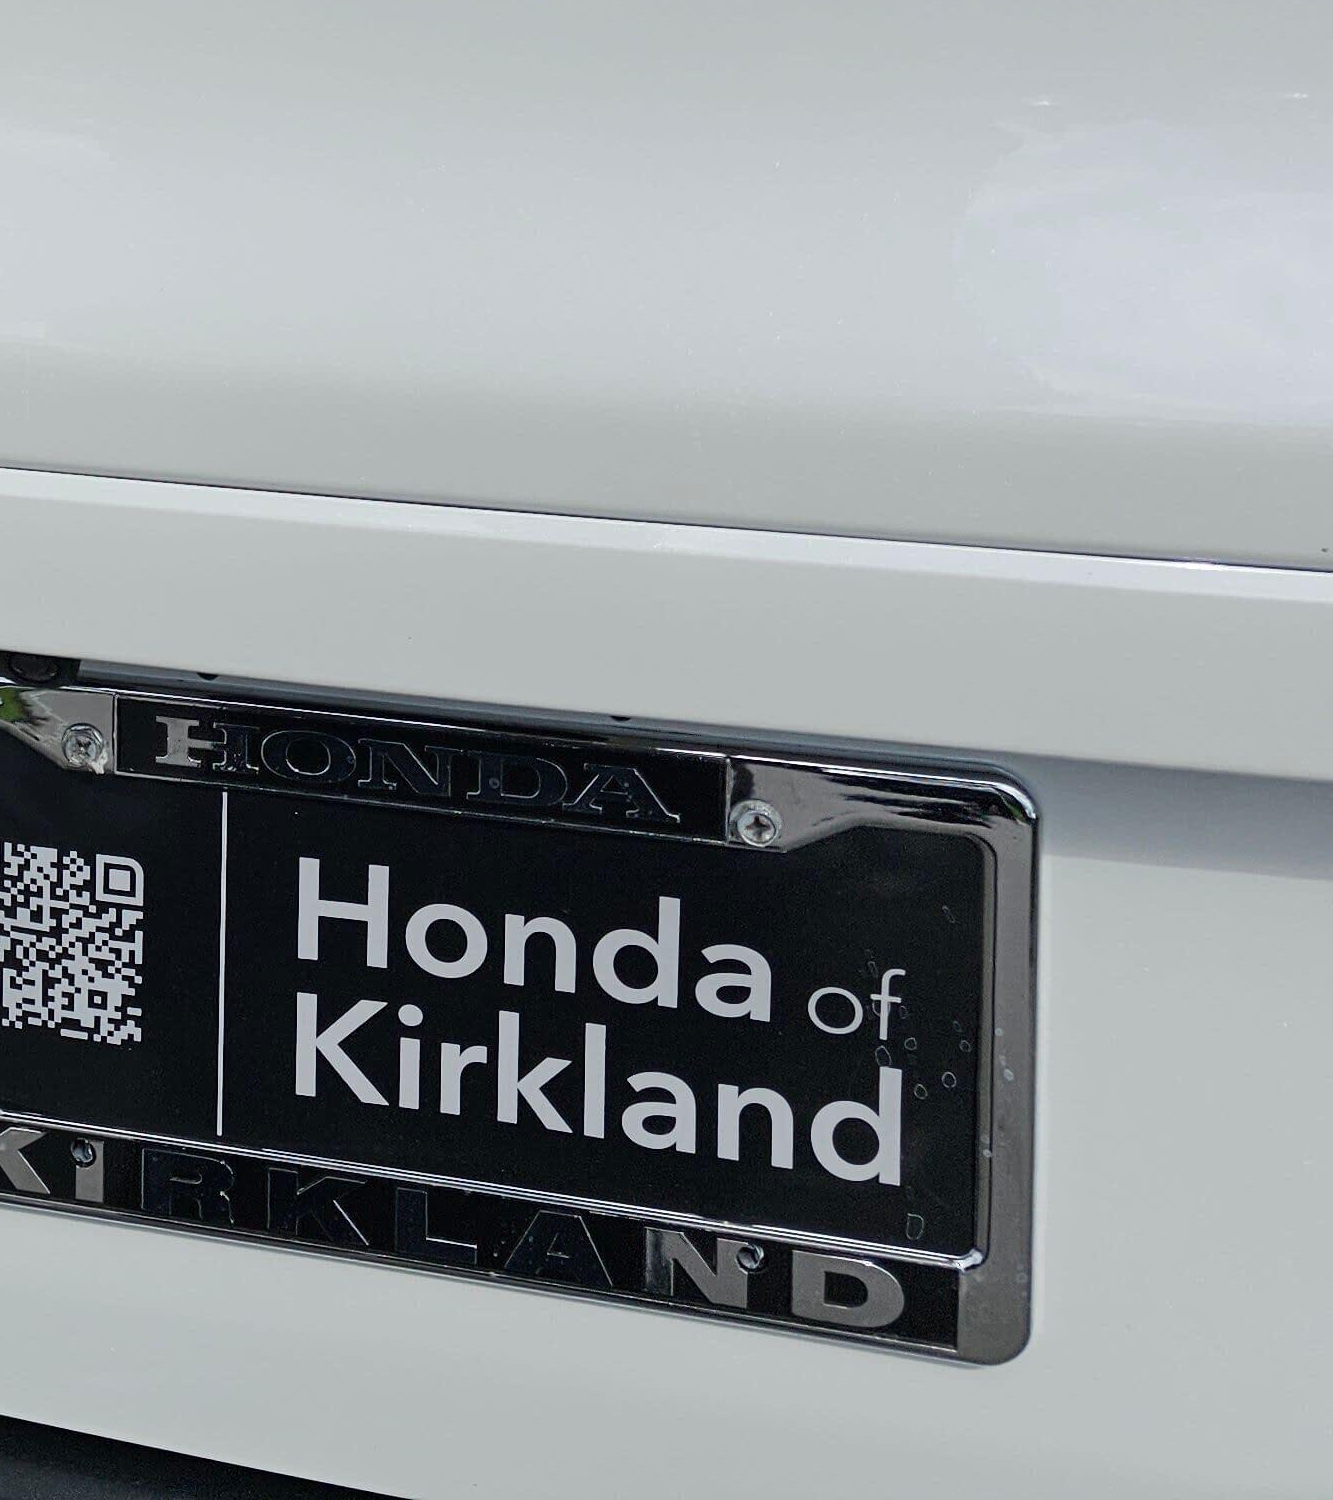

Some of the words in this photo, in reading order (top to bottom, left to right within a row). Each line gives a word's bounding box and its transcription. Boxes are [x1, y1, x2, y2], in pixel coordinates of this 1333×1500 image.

[155, 714, 682, 824] HONDA
[296, 857, 772, 1022] Honda
[808, 968, 905, 1041] of
[294, 993, 904, 1187] Kirkland
